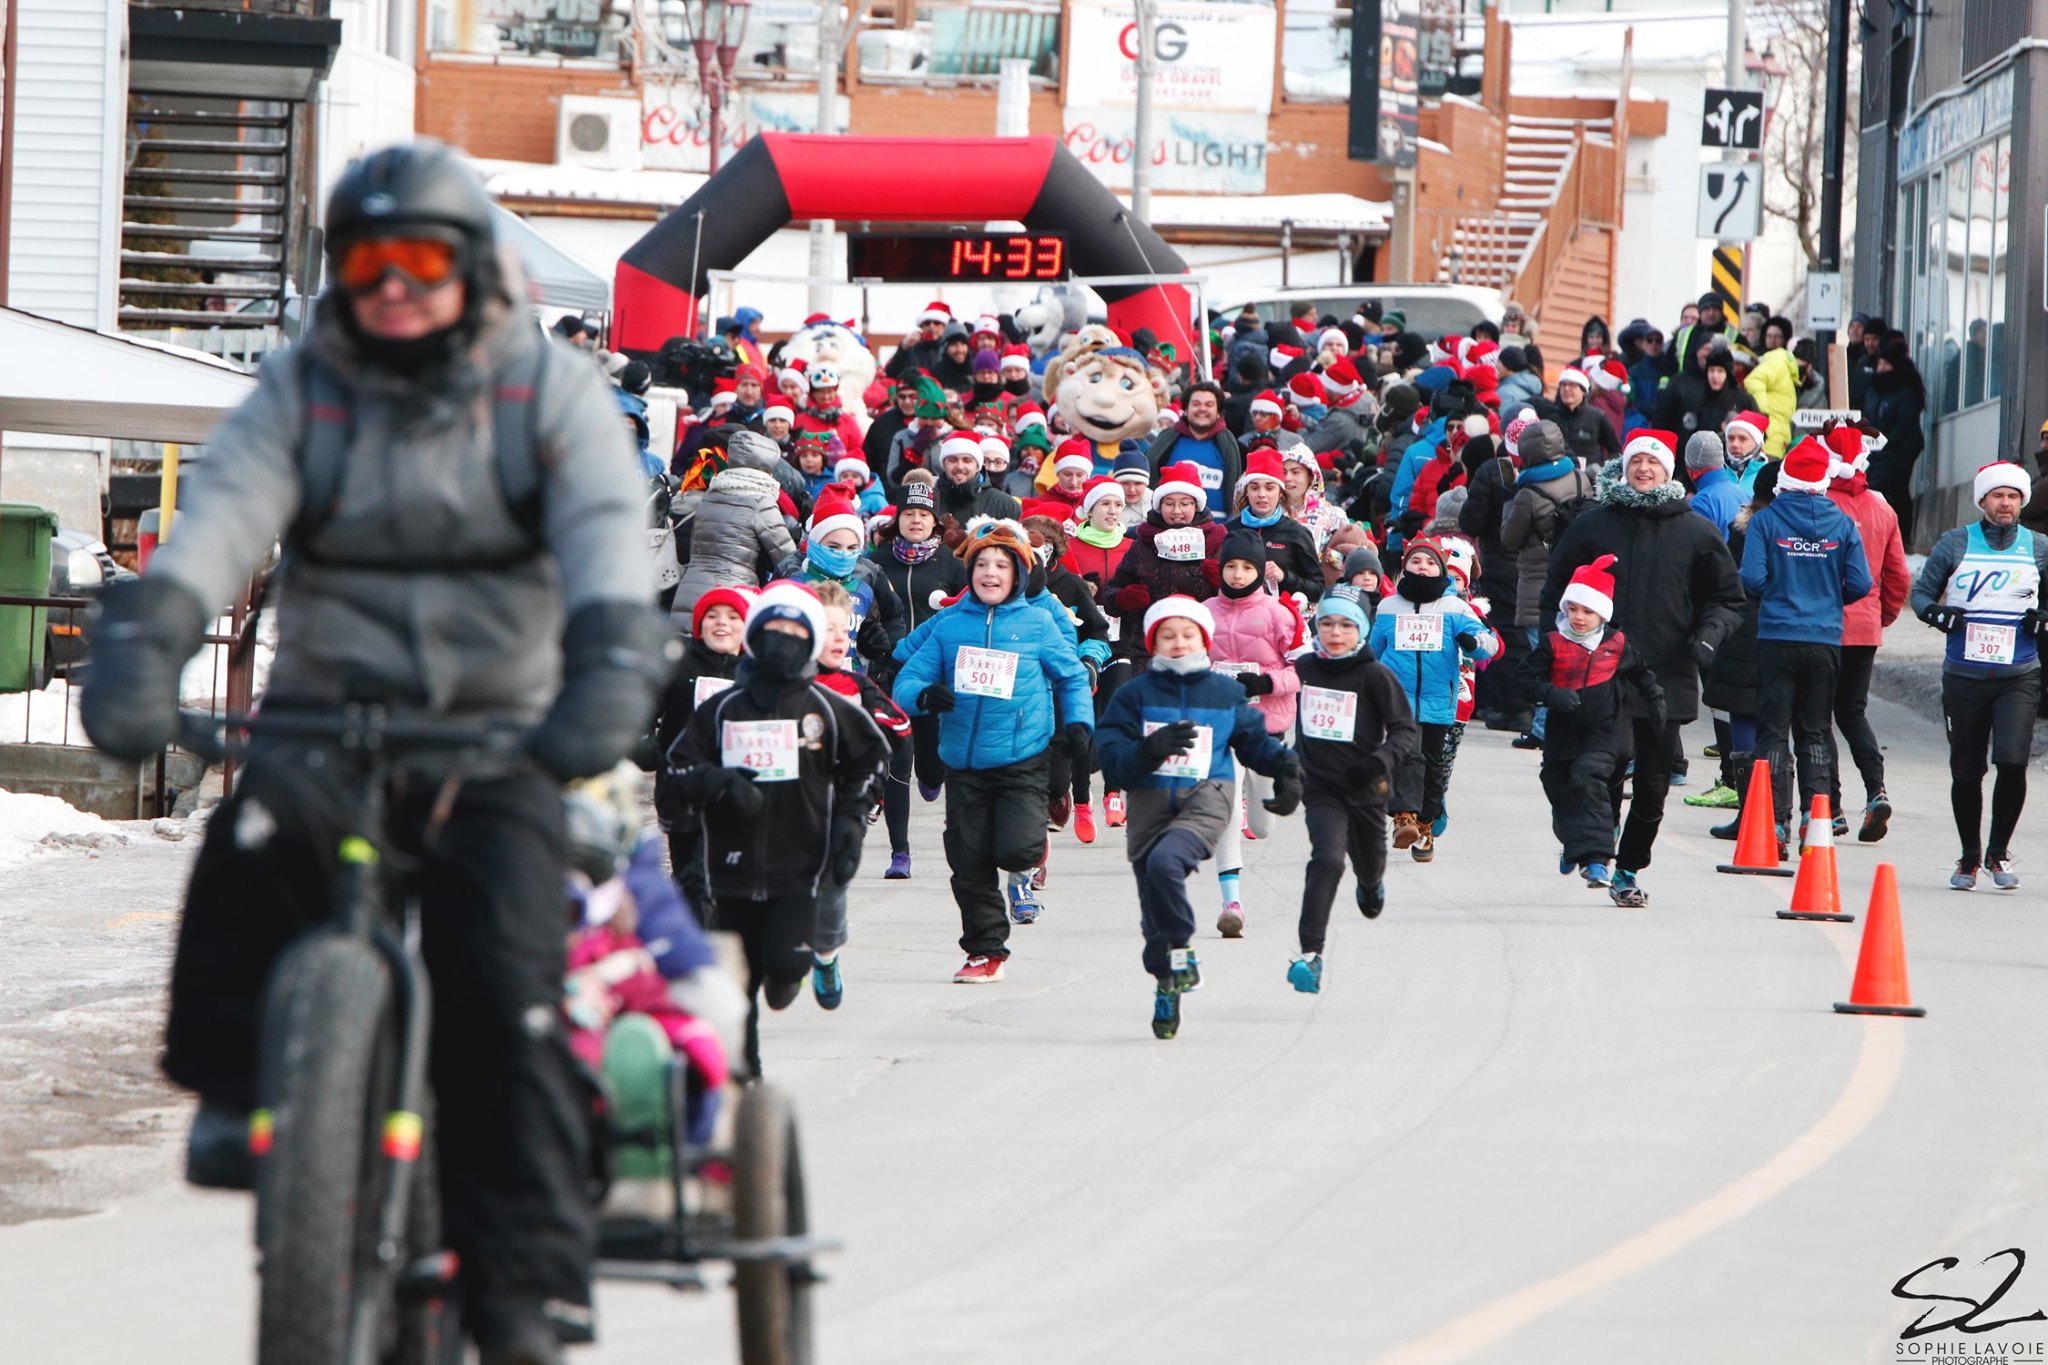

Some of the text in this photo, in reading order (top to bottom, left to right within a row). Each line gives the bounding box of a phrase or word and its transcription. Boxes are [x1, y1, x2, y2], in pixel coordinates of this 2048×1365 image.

[1064, 123, 1265, 168] Coos LIGHT
[1169, 543, 1191, 554] 448
[1793, 542, 1820, 552] OCR
[1408, 632, 1429, 642] 447
[1979, 643, 2000, 655] 307
[970, 671, 994, 686] 501
[1310, 713, 1336, 729] 439
[742, 751, 774, 768] 423
